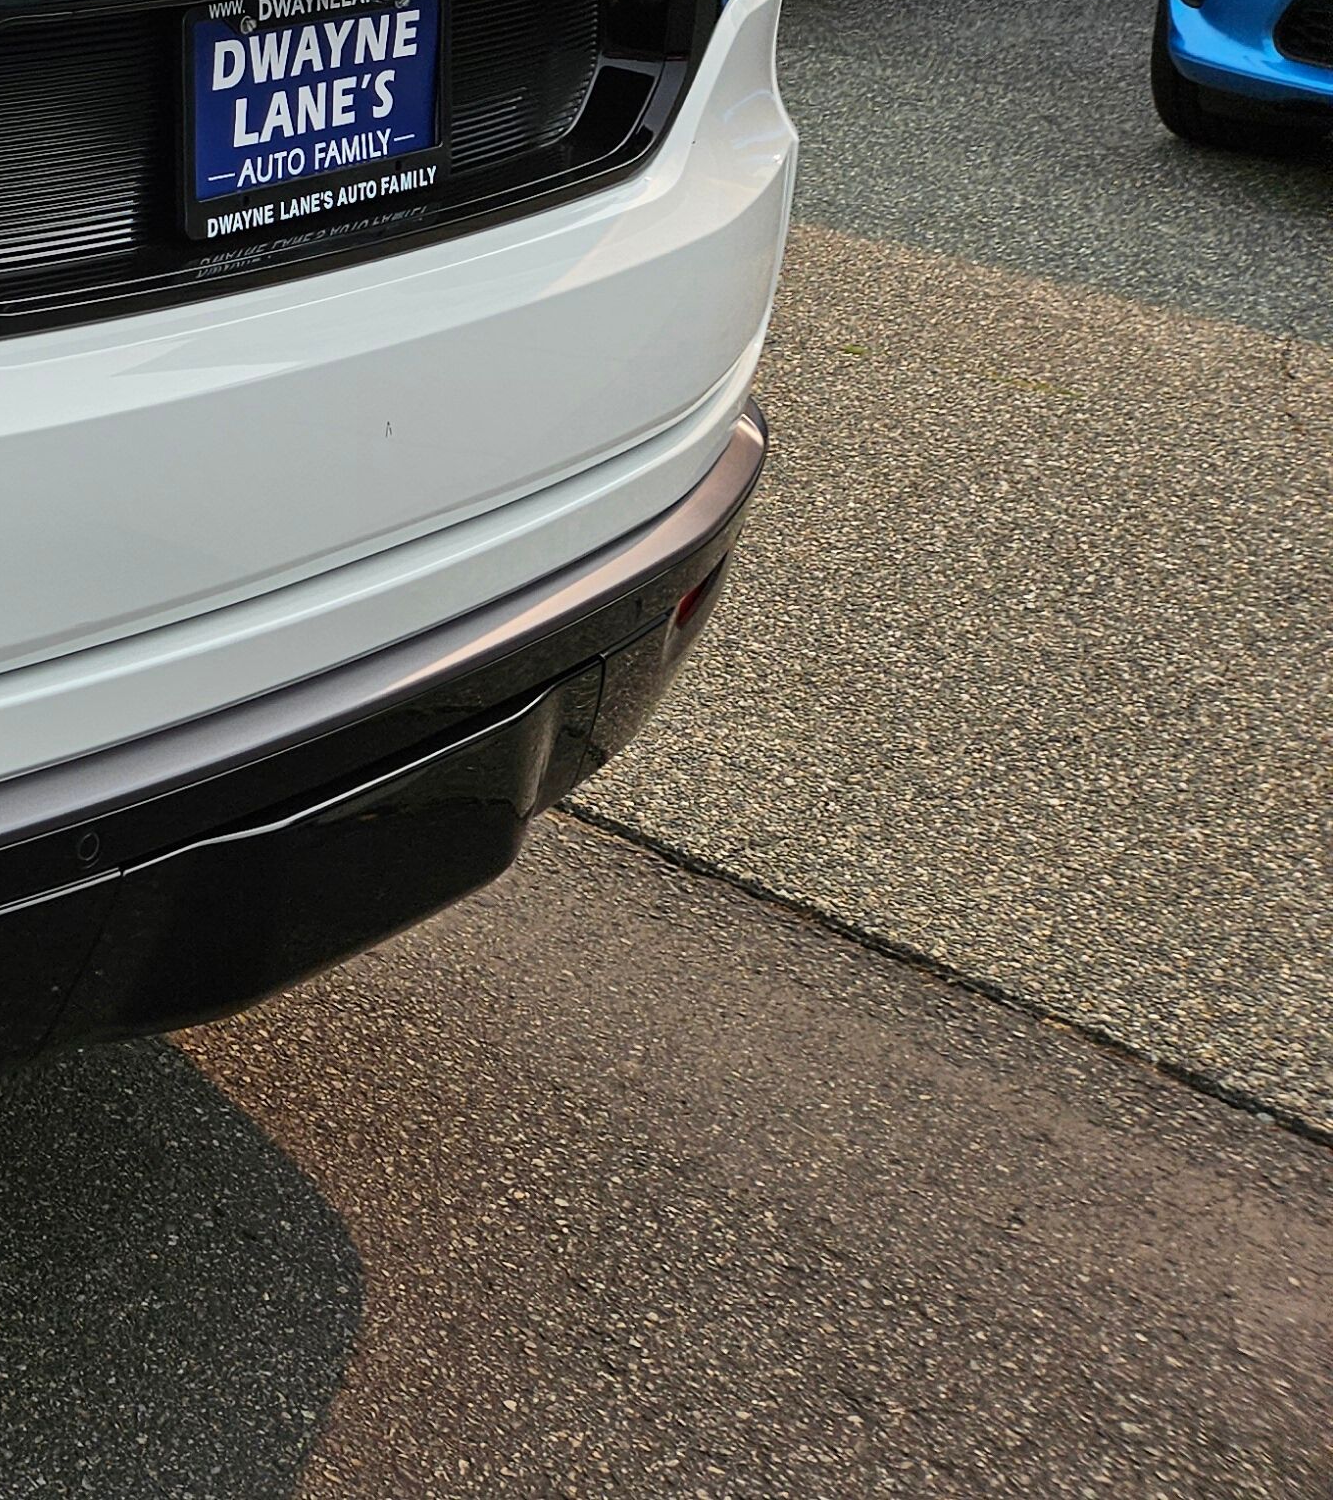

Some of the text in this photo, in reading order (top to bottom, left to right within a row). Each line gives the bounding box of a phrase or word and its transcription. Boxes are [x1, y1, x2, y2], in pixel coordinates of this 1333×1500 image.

[207, 0, 246, 19] WWW.
[211, 9, 421, 92] DWAYNE
[232, 69, 397, 149] LANE'S
[236, 128, 393, 188] AUTO FAMILY
[206, 204, 275, 239] DWAYNE
[279, 191, 334, 221] LANE'S
[336, 179, 378, 206] AUTO
[380, 165, 438, 197] FAMILY
